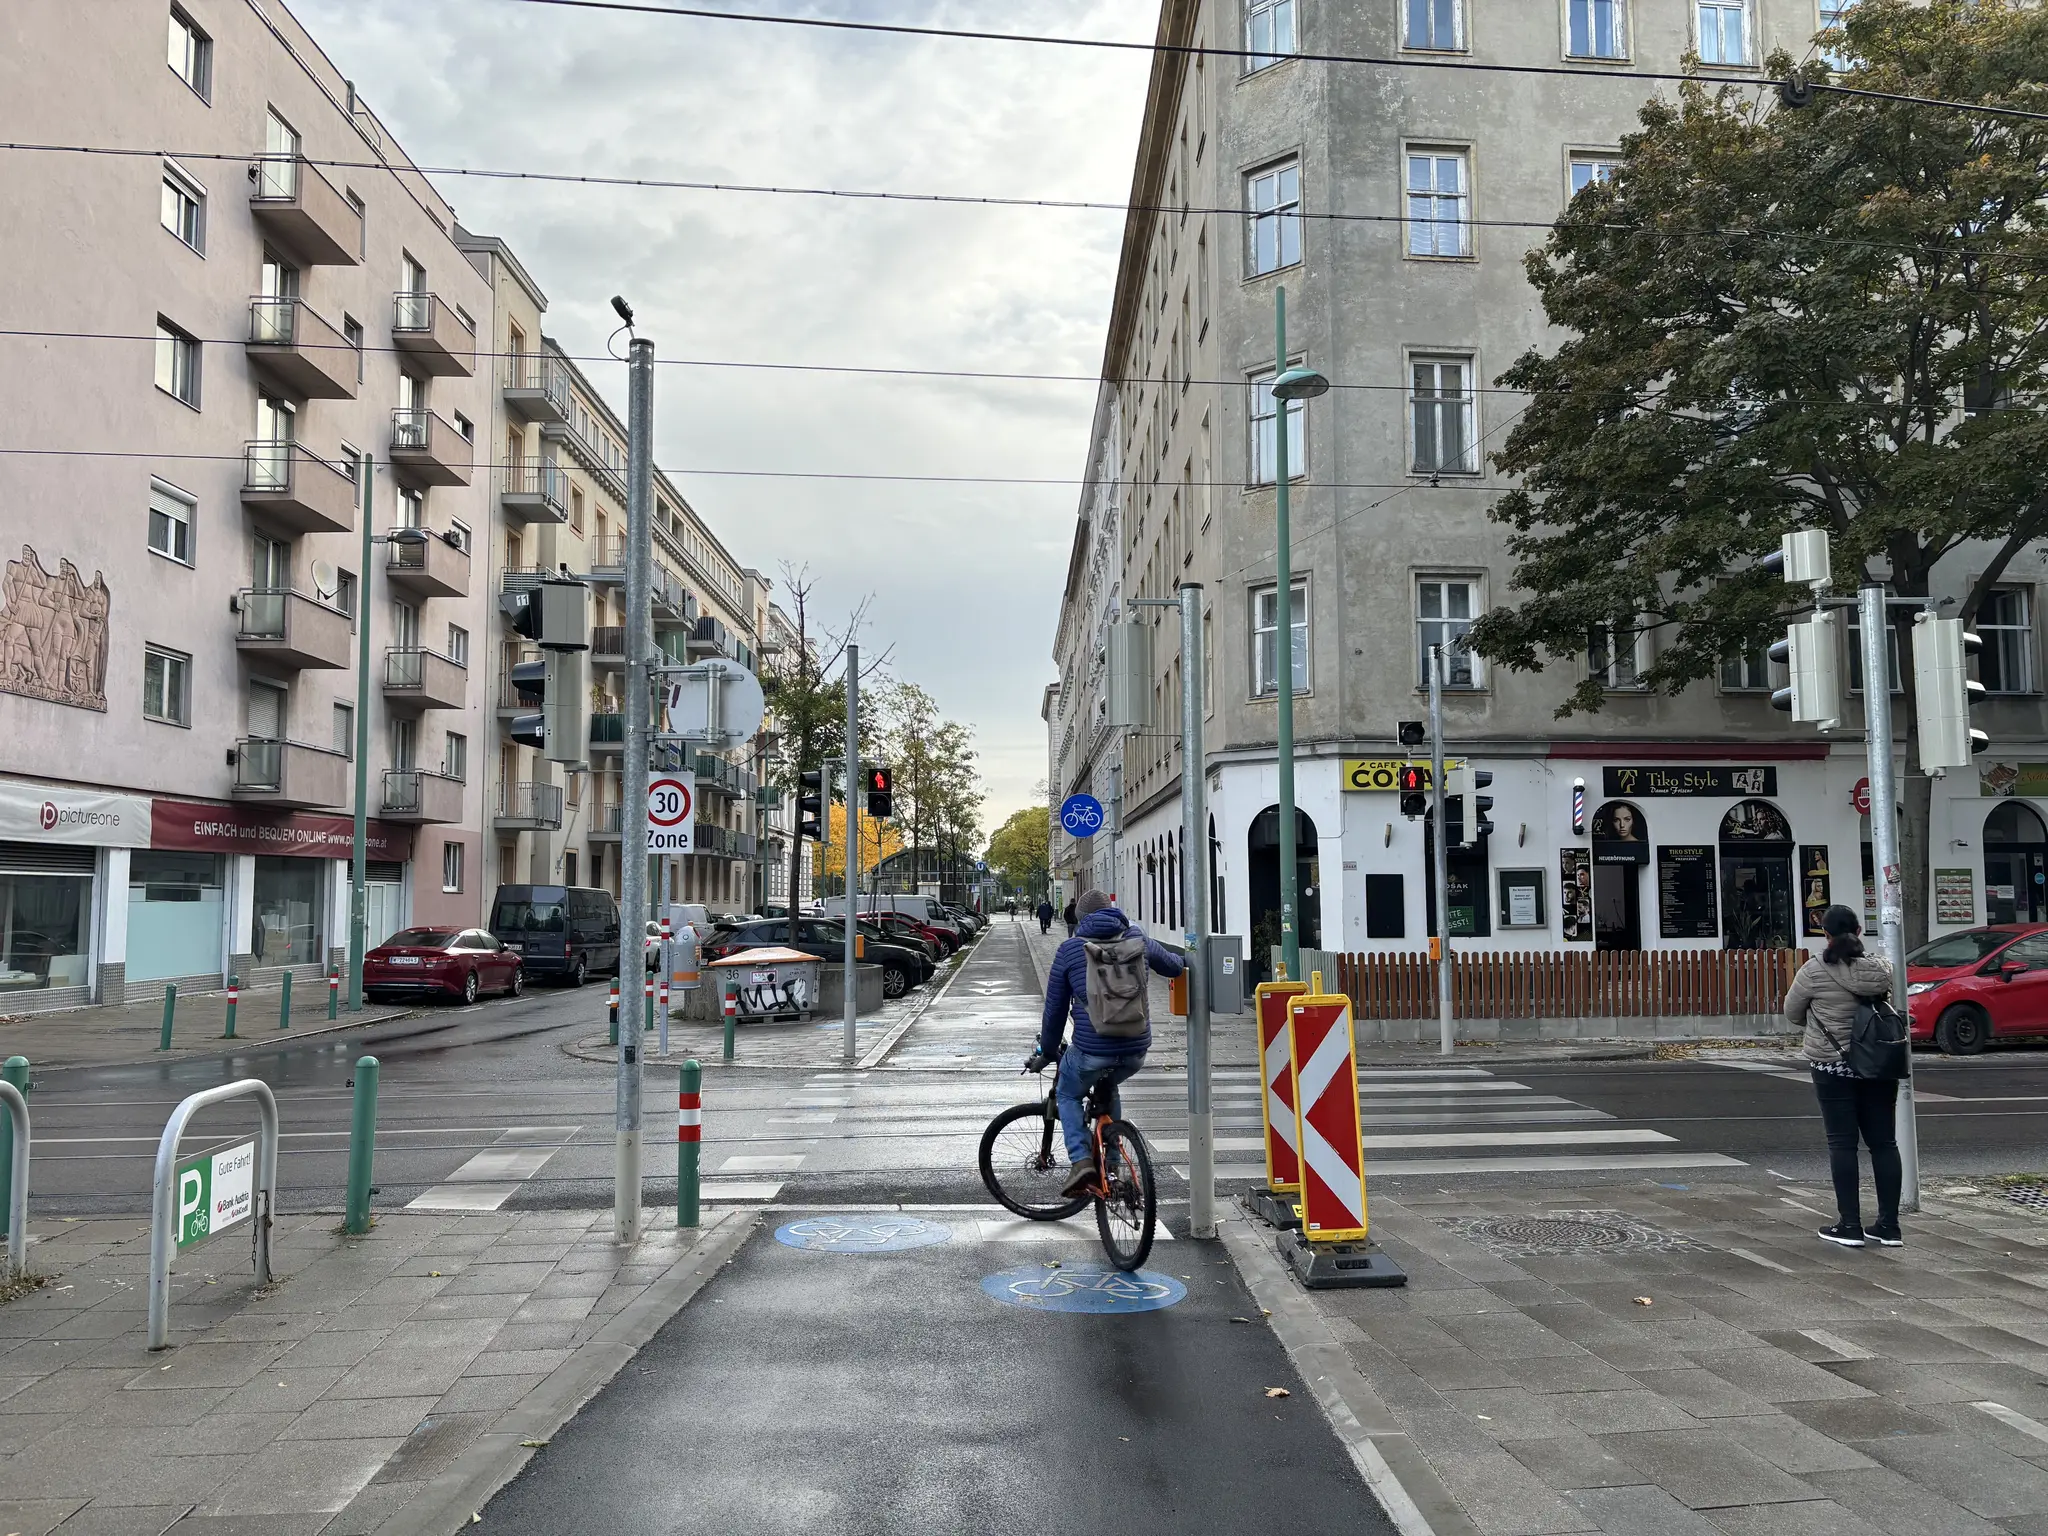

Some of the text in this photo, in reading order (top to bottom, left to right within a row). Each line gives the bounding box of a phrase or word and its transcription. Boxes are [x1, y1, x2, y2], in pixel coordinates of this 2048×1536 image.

[1646, 770, 1719, 789] Tiko Style
[655, 792, 679, 813] 30
[59, 807, 120, 827] pictureone
[194, 821, 237, 837] EINFACH
[239, 825, 256, 839] und
[258, 827, 295, 842] BEQUEM
[296, 829, 327, 844] ONLINE
[648, 830, 688, 848] Zone
[726, 970, 740, 980] 36
[218, 1152, 251, 1176] Gute Fahrt!
[178, 1169, 203, 1243] P
[223, 1190, 249, 1211] Bank Austria
